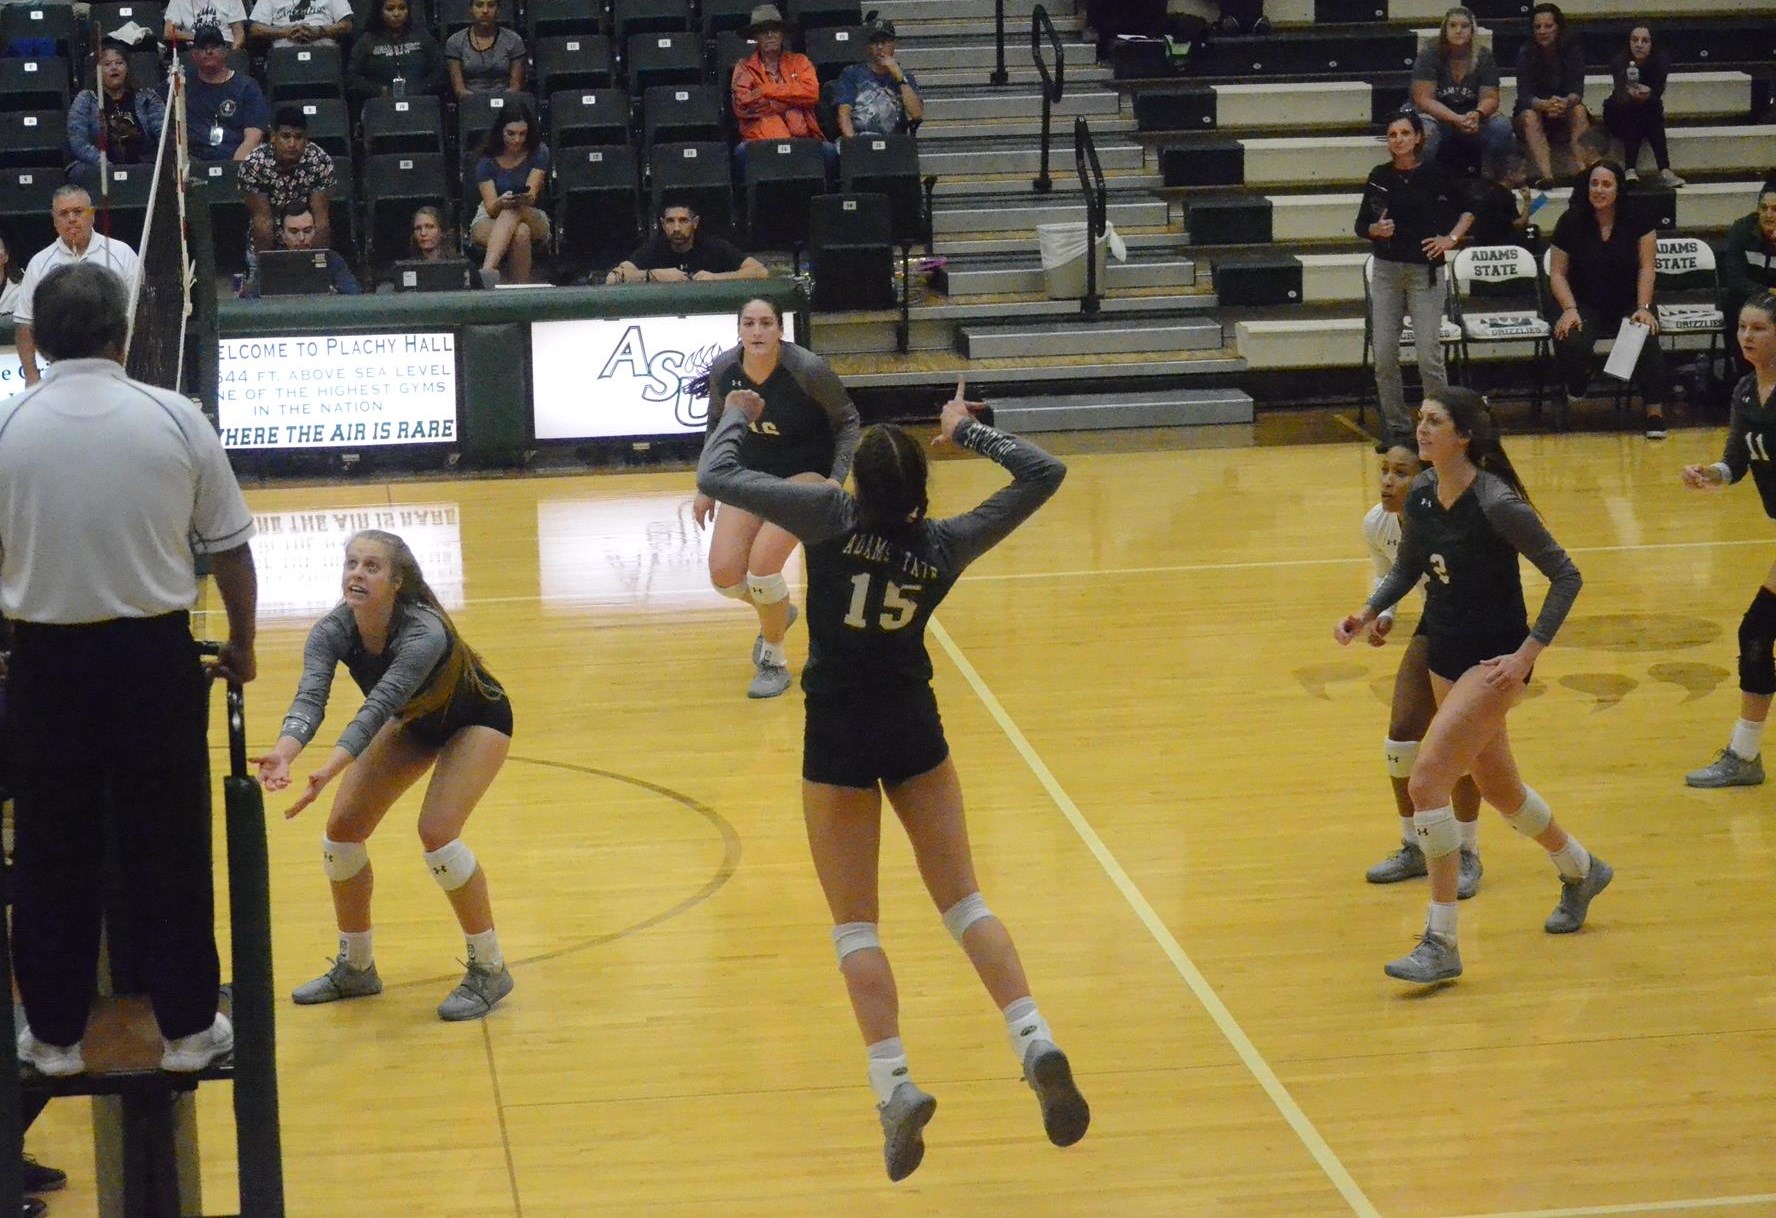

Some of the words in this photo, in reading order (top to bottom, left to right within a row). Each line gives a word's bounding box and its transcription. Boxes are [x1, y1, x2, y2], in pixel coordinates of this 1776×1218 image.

[1471, 249, 1518, 261] ADAMS
[1655, 257, 1697, 269] STATE
[1474, 264, 1518, 276] STATE
[219, 343, 287, 360] ELCOME
[296, 341, 318, 357] TO
[327, 337, 396, 356] PLACHY
[405, 335, 453, 353] HALL
[289, 368, 346, 381] ABOVE
[355, 366, 386, 379] SEA
[396, 364, 451, 377] LEVEL
[218, 389, 237, 401] NE
[246, 388, 266, 400] OF
[276, 387, 308, 398] THE
[318, 383, 391, 397] HIGHEST
[400, 381, 446, 394] GYMS
[254, 404, 269, 416] IN
[280, 403, 311, 415] THE
[321, 400, 382, 414] NATION
[220, 426, 279, 446] HERE
[286, 424, 325, 443] THE
[330, 422, 366, 441] AIR
[373, 421, 391, 440] IS
[397, 419, 454, 438] RARE
[1745, 431, 1770, 461] 11
[843, 572, 922, 631] 15
